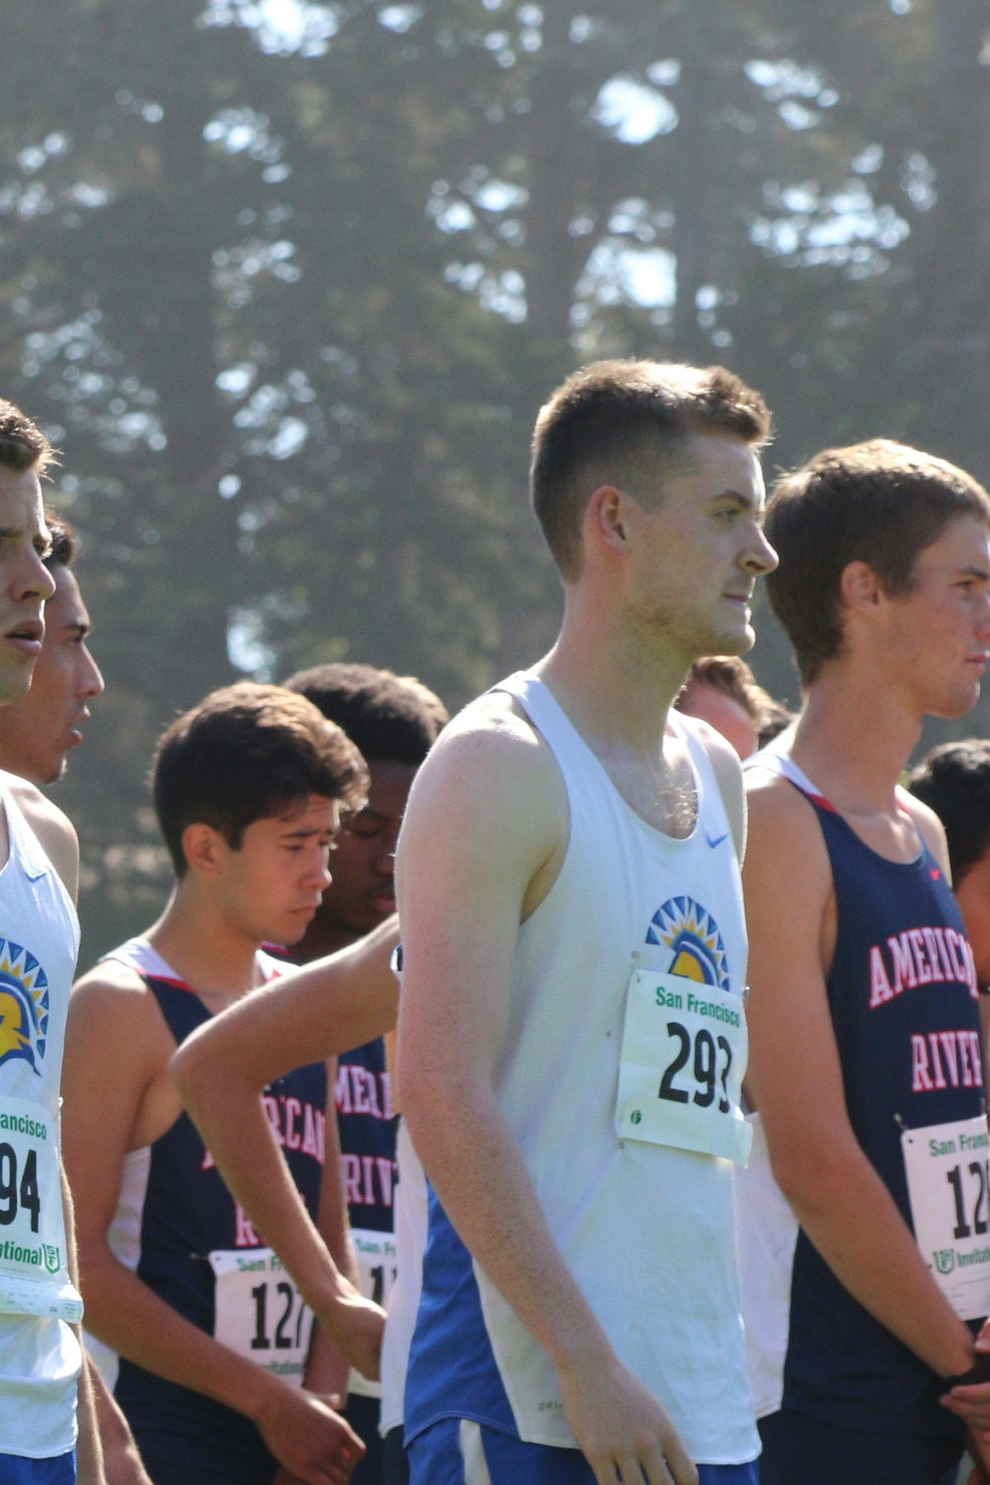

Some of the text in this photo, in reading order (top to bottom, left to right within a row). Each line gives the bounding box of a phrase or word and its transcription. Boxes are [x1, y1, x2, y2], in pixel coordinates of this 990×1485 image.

[655, 985, 683, 1011] San
[659, 1021, 733, 1115] 293
[929, 1137, 957, 1157] San
[235, 1258, 266, 1272] San
